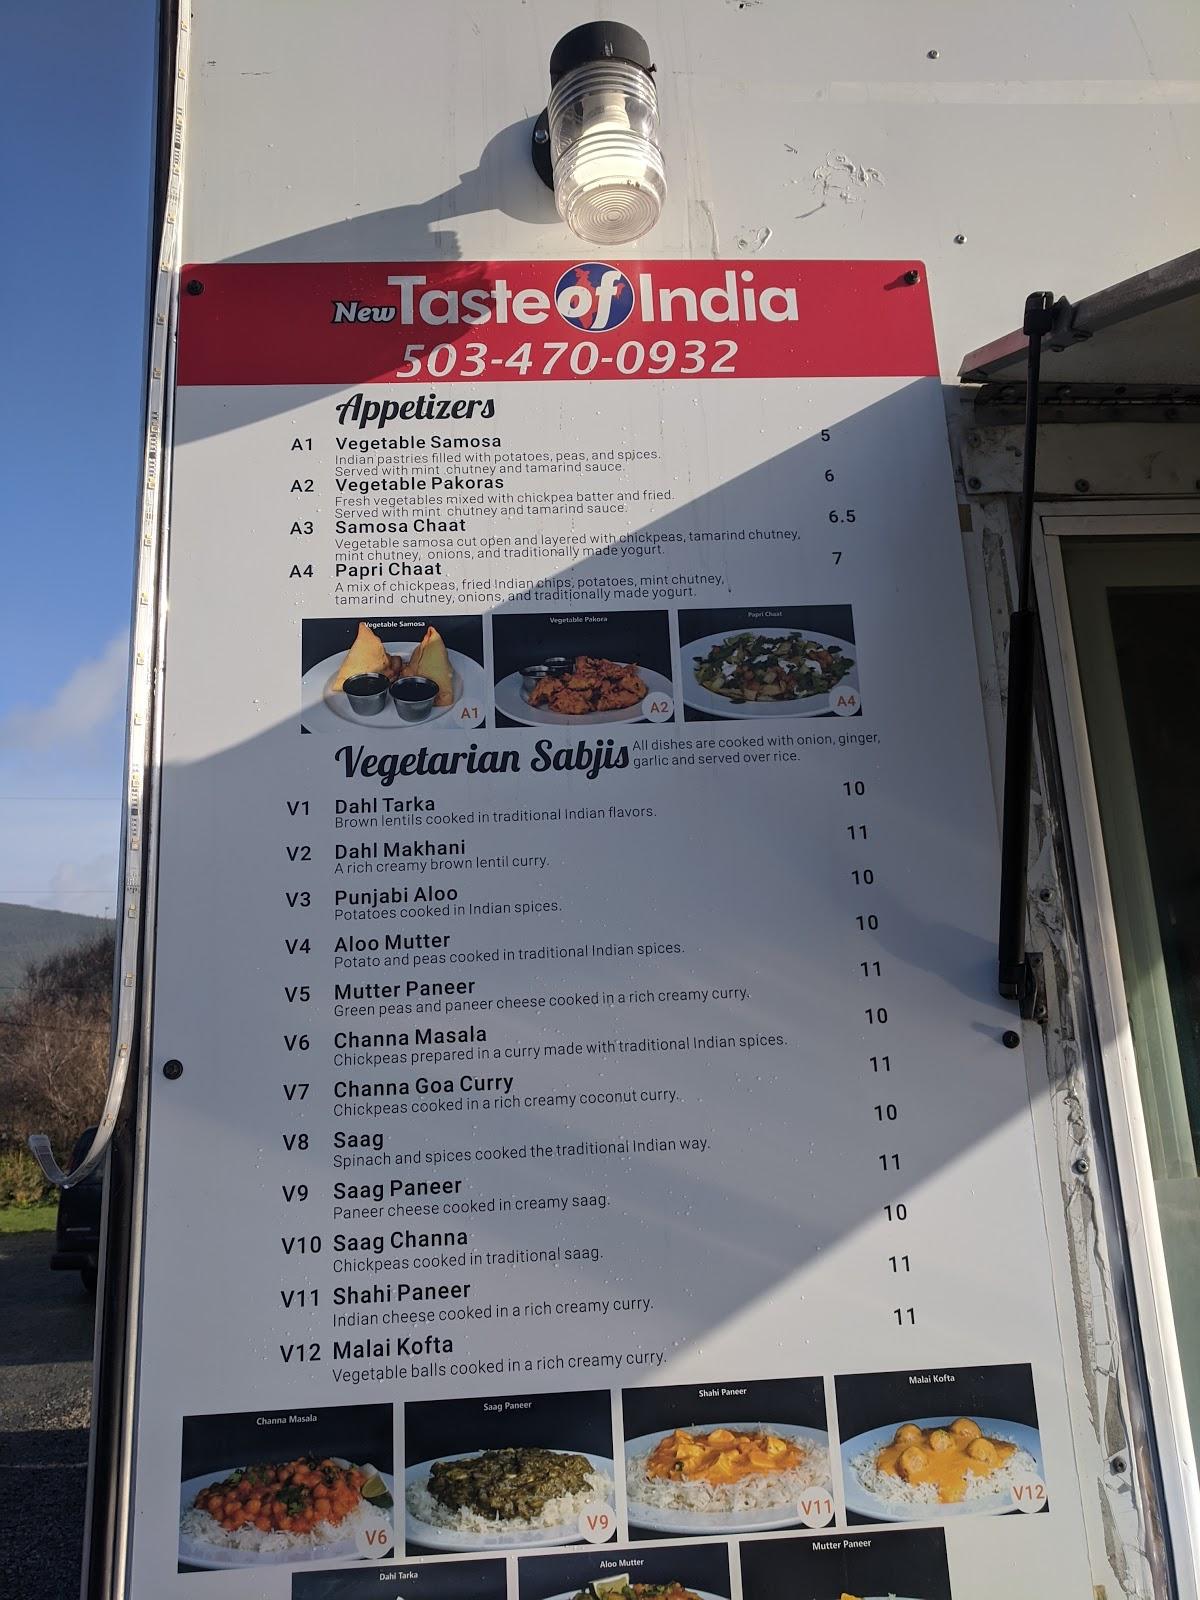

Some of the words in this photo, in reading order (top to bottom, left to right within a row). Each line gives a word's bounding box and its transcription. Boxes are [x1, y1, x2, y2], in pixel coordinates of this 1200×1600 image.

[333, 302, 397, 325] New
[388, 276, 551, 326] Taste
[556, 269, 623, 329] of
[640, 270, 799, 323] India
[396, 338, 739, 379] 503-470-0932
[335, 393, 495, 429] Appetizers
[291, 438, 311, 451] A1
[336, 435, 426, 453] Vegetable
[431, 435, 501, 448] Samosa
[821, 429, 830, 442] 5
[825, 469, 834, 482] 6
[290, 479, 314, 492] A2
[335, 477, 426, 494] Vegetable
[432, 476, 504, 490] Pakoras
[829, 510, 856, 523] 6.5
[290, 521, 313, 535] A3
[336, 520, 408, 534] Samosa
[414, 518, 466, 532] Chaat
[335, 538, 399, 552] Vegetable
[402, 538, 453, 550] samosa
[456, 537, 477, 547] cut
[480, 536, 511, 549] open
[514, 534, 537, 547] and
[541, 533, 586, 549] layered
[590, 533, 617, 545] with
[620, 532, 687, 547] chickpeas,
[689, 530, 745, 541] tamarind
[748, 530, 800, 542] chutney,
[832, 552, 842, 565] 7
[289, 564, 314, 578] A4
[336, 562, 383, 580] Papri
[389, 562, 442, 576] Chaat
[364, 621, 399, 629] Vegetable
[550, 616, 583, 625] Vegetable
[650, 701, 669, 713] A2
[837, 695, 856, 707] A4
[461, 707, 478, 719] A1
[632, 739, 648, 751] All
[651, 739, 692, 750] dishes
[695, 740, 715, 749] are
[718, 736, 764, 748] cooked
[767, 734, 794, 746] with
[796, 734, 835, 745] onion,
[838, 732, 880, 747] ginger,
[335, 743, 521, 786] Vegetarian
[530, 739, 629, 779] Sabjis
[633, 755, 669, 769] garlic
[671, 753, 695, 765] and
[698, 752, 740, 764] served
[743, 753, 771, 763] over
[773, 750, 800, 762] rice.
[843, 781, 865, 796] 10
[287, 801, 309, 816] V1
[336, 797, 377, 814] Dahl
[382, 796, 435, 812] Tarka
[335, 817, 378, 828] Brown
[382, 814, 423, 826] lentils
[426, 812, 474, 825] cooked
[478, 811, 490, 823] in
[493, 809, 561, 823] traditional
[565, 808, 605, 820] Indian
[608, 806, 657, 818] flavors.
[847, 825, 867, 840] 11
[286, 846, 311, 861] V2
[336, 842, 377, 859] Dahl
[384, 839, 465, 857] Makhani
[851, 869, 874, 885] 10
[285, 892, 310, 908] V3
[335, 887, 408, 908] Punjabi
[414, 885, 458, 903] Aloo
[856, 915, 878, 930] 10
[285, 938, 311, 955] V4
[334, 935, 379, 952] Aloo
[385, 934, 450, 950] Mutter
[335, 956, 380, 968] Potato
[384, 953, 409, 966] and
[413, 954, 446, 968] peas
[450, 948, 499, 963] cooked
[503, 949, 515, 960] in
[518, 944, 588, 960] traditional
[592, 944, 634, 957] Indian
[637, 942, 685, 957] spices.
[860, 961, 880, 977] 11
[284, 986, 310, 1003] V5
[335, 983, 400, 1000] Mutter
[406, 981, 475, 997] Paneer
[865, 1008, 888, 1024] 10
[284, 1034, 310, 1051] V6
[334, 1031, 409, 1049] Channa
[416, 1025, 487, 1045] Masala
[870, 1056, 890, 1072] 11
[283, 1083, 309, 1101] V7
[334, 1080, 409, 1098] Channa
[416, 1077, 454, 1094] Goa
[460, 1075, 515, 1095] Curry
[874, 1104, 897, 1121] 10
[283, 1133, 309, 1151] V8
[334, 1131, 383, 1151] Saag
[879, 1153, 900, 1171] 11
[282, 1184, 308, 1202] V9
[334, 1182, 384, 1202] Saag
[391, 1180, 462, 1197] Paneer
[334, 1206, 384, 1219] Paneer
[388, 1204, 439, 1217] cheese
[443, 1199, 495, 1214] cooked
[499, 1198, 511, 1211] in
[515, 1197, 568, 1211] creamy
[572, 1195, 610, 1209] saag.
[883, 1204, 907, 1221] 10
[281, 1236, 321, 1254] V10
[333, 1234, 384, 1254] Saag
[391, 1230, 467, 1248] Channa
[889, 1255, 910, 1273] 11
[280, 1290, 318, 1308] V11
[333, 1284, 391, 1305] Shahi
[398, 1284, 471, 1301] Paneer
[894, 1308, 915, 1325] 11
[280, 1344, 321, 1363] V12
[334, 1338, 390, 1360] Malai
[398, 1336, 453, 1356] Kofta
[332, 1366, 407, 1385] Vegetable
[411, 1364, 446, 1378] balls
[450, 1360, 503, 1375] cooked
[508, 1361, 520, 1372] in
[524, 1360, 532, 1371] a
[537, 1357, 564, 1370] rich
[568, 1354, 622, 1369] creamy
[626, 1352, 666, 1367] curry.
[909, 1375, 931, 1384] Malai
[933, 1374, 955, 1382] Kofta
[699, 1388, 719, 1397] Shahi
[721, 1388, 747, 1396] Paneer
[483, 1403, 502, 1412] Saag
[505, 1402, 532, 1410] Paneer
[256, 1417, 287, 1425] Channa
[289, 1414, 317, 1423] Masala
[1013, 1484, 1046, 1503] V12
[801, 1498, 833, 1517] V11
[587, 1515, 608, 1530] V9
[365, 1529, 387, 1545] V6
[812, 1542, 841, 1550] Mutter
[843, 1540, 872, 1548] Paneer
[600, 1560, 617, 1568] Aloo
[619, 1559, 644, 1567] Mutter
[398, 1571, 418, 1579] Tarka
